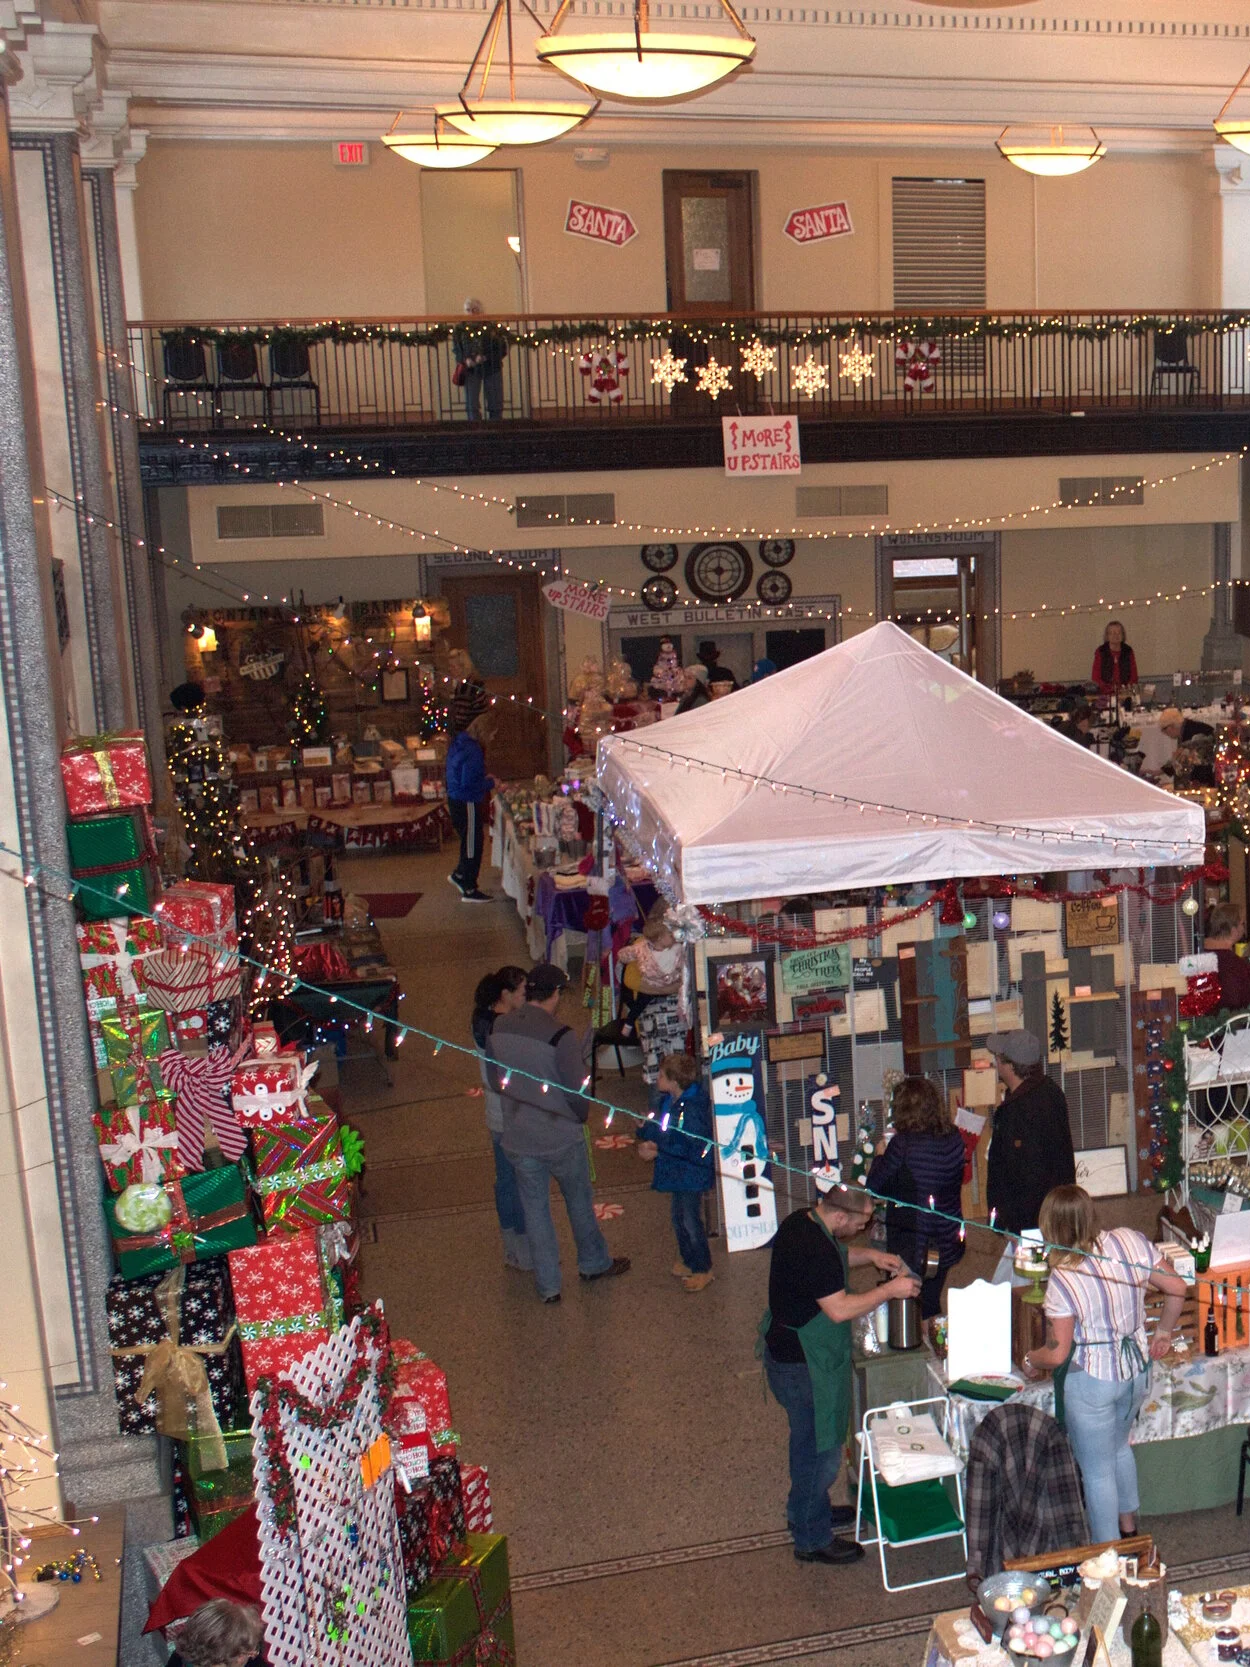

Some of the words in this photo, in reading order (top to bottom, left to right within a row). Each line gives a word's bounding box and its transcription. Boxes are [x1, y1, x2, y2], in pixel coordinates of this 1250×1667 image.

[338, 142, 364, 163] EXIT
[569, 204, 628, 241] SANTA
[792, 206, 849, 239] SANTA
[742, 428, 784, 447] MORE
[727, 453, 800, 471] UPSTAIRS
[548, 588, 608, 618] UPSTAIRS
[564, 584, 608, 605] MORE
[627, 613, 673, 626] WEST
[684, 607, 762, 623] BULLETIN
[774, 605, 815, 618] EAST
[789, 947, 840, 974] CHRISTMAS
[814, 963, 842, 978] TREES
[709, 1031, 761, 1062] Baby
